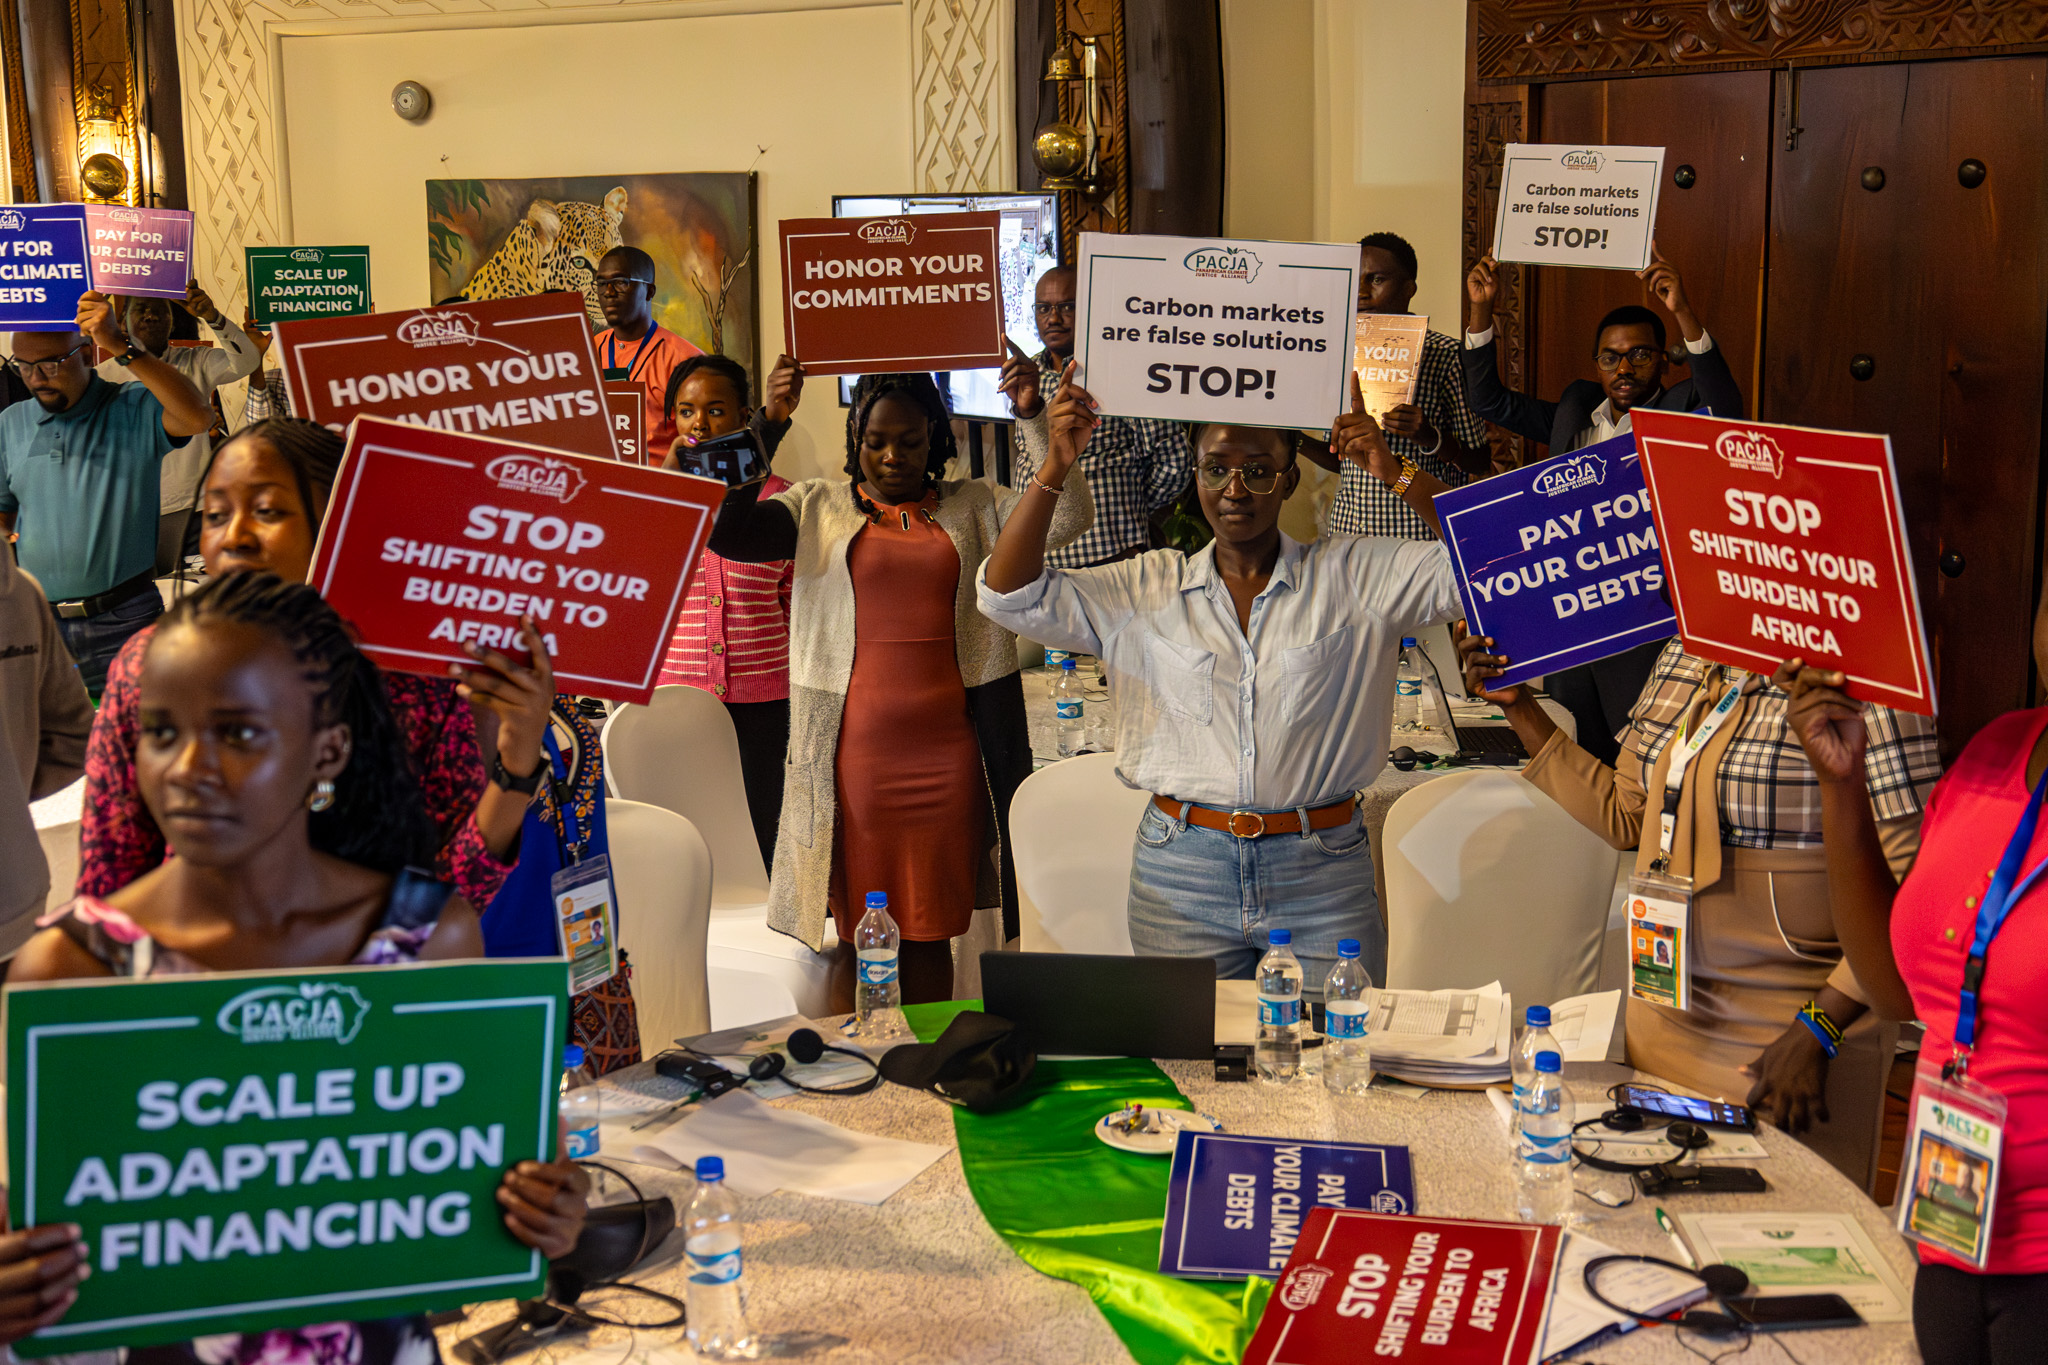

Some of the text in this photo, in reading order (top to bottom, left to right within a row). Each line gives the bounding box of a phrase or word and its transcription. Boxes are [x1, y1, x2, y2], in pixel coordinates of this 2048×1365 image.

[1568, 155, 1597, 165] PACJA
[1526, 183, 1639, 199] Carbon markets
[0, 214, 19, 224] CJA
[114, 211, 139, 220] PACJA
[1512, 202, 1639, 218] are false solutions
[95, 229, 163, 244] PAY FOR
[866, 225, 907, 237] PACJA
[1533, 226, 1609, 250] STOP!
[13, 240, 53, 257] FOR
[90, 245, 185, 262] UR CLIMATE
[295, 251, 319, 259] PACJA
[1196, 254, 1249, 271] PACJA
[0, 263, 83, 280] CLIMATE
[99, 262, 152, 276] DEBTS
[274, 268, 348, 281] SCALE UP
[805, 253, 984, 280] HONOR YOUR
[0, 287, 47, 303] EBTS
[260, 284, 359, 297] ADAPTATION
[793, 282, 992, 310] COMMITMENTS
[269, 301, 352, 313] FINANCING
[1125, 295, 1325, 325] Carbon markets
[409, 319, 467, 339] PACJA
[1101, 324, 1327, 353] are false solutions
[1363, 346, 1410, 362] YOUR
[328, 350, 582, 408] HONOR YOUR
[1146, 362, 1277, 401] STOP!
[1725, 439, 1774, 462] PACJA
[500, 461, 568, 489] PACJA
[1542, 462, 1596, 490] PACJA
[1724, 487, 1822, 537] STOP
[463, 503, 605, 555] STOP
[1518, 509, 1583, 551] PAY
[380, 536, 650, 602] SHIFTING YOUR
[1472, 525, 1660, 603] YOUR CLIM
[1689, 528, 1879, 589] SHIFTING YOUR
[402, 576, 608, 629] BURDEN TO
[1552, 564, 1664, 620] DEBTS
[1716, 569, 1861, 623] BURDEN TO
[1750, 612, 1843, 657] AFRICA
[241, 997, 344, 1027] PACJA
[135, 1060, 466, 1131] SCALE UP
[63, 1122, 506, 1207] ADAPTATION
[1272, 1145, 1302, 1191] YOUR
[1224, 1172, 1257, 1231] DEBTS
[1317, 1173, 1346, 1208] PAY
[1381, 1195, 1397, 1214] PAC
[100, 1190, 472, 1273] FINANCING
[1290, 1271, 1316, 1308] PACJA
[1336, 1253, 1391, 1320] STOP
[1374, 1231, 1441, 1358] SHIFTING YOUR
[1420, 1247, 1475, 1347] BURDEN TO
[1467, 1266, 1511, 1333] AFRICA
